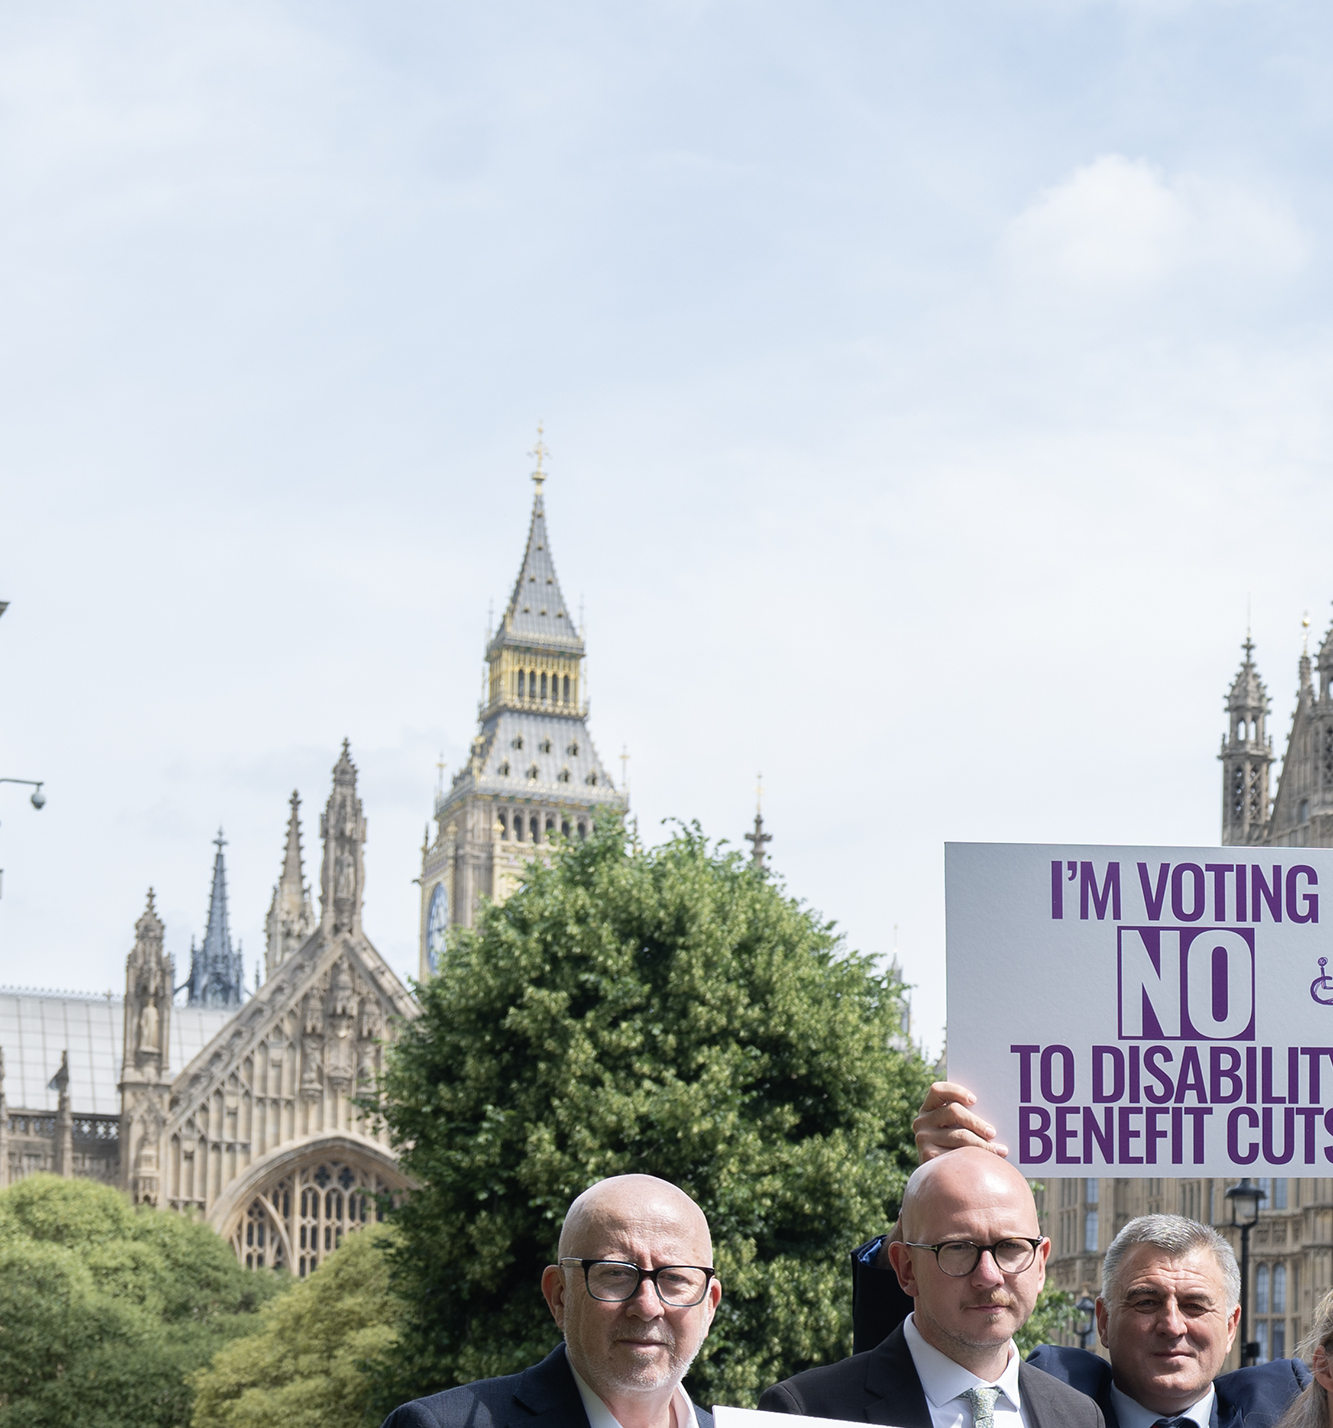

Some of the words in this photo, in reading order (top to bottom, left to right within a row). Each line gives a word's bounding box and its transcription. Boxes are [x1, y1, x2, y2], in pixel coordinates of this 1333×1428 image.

[1050, 860, 1121, 920] I'M
[1137, 862, 1319, 923] VOTING
[1121, 929, 1252, 1038] NO
[1010, 1044, 1075, 1103] TO
[1018, 1107, 1213, 1164] BENEFIT
